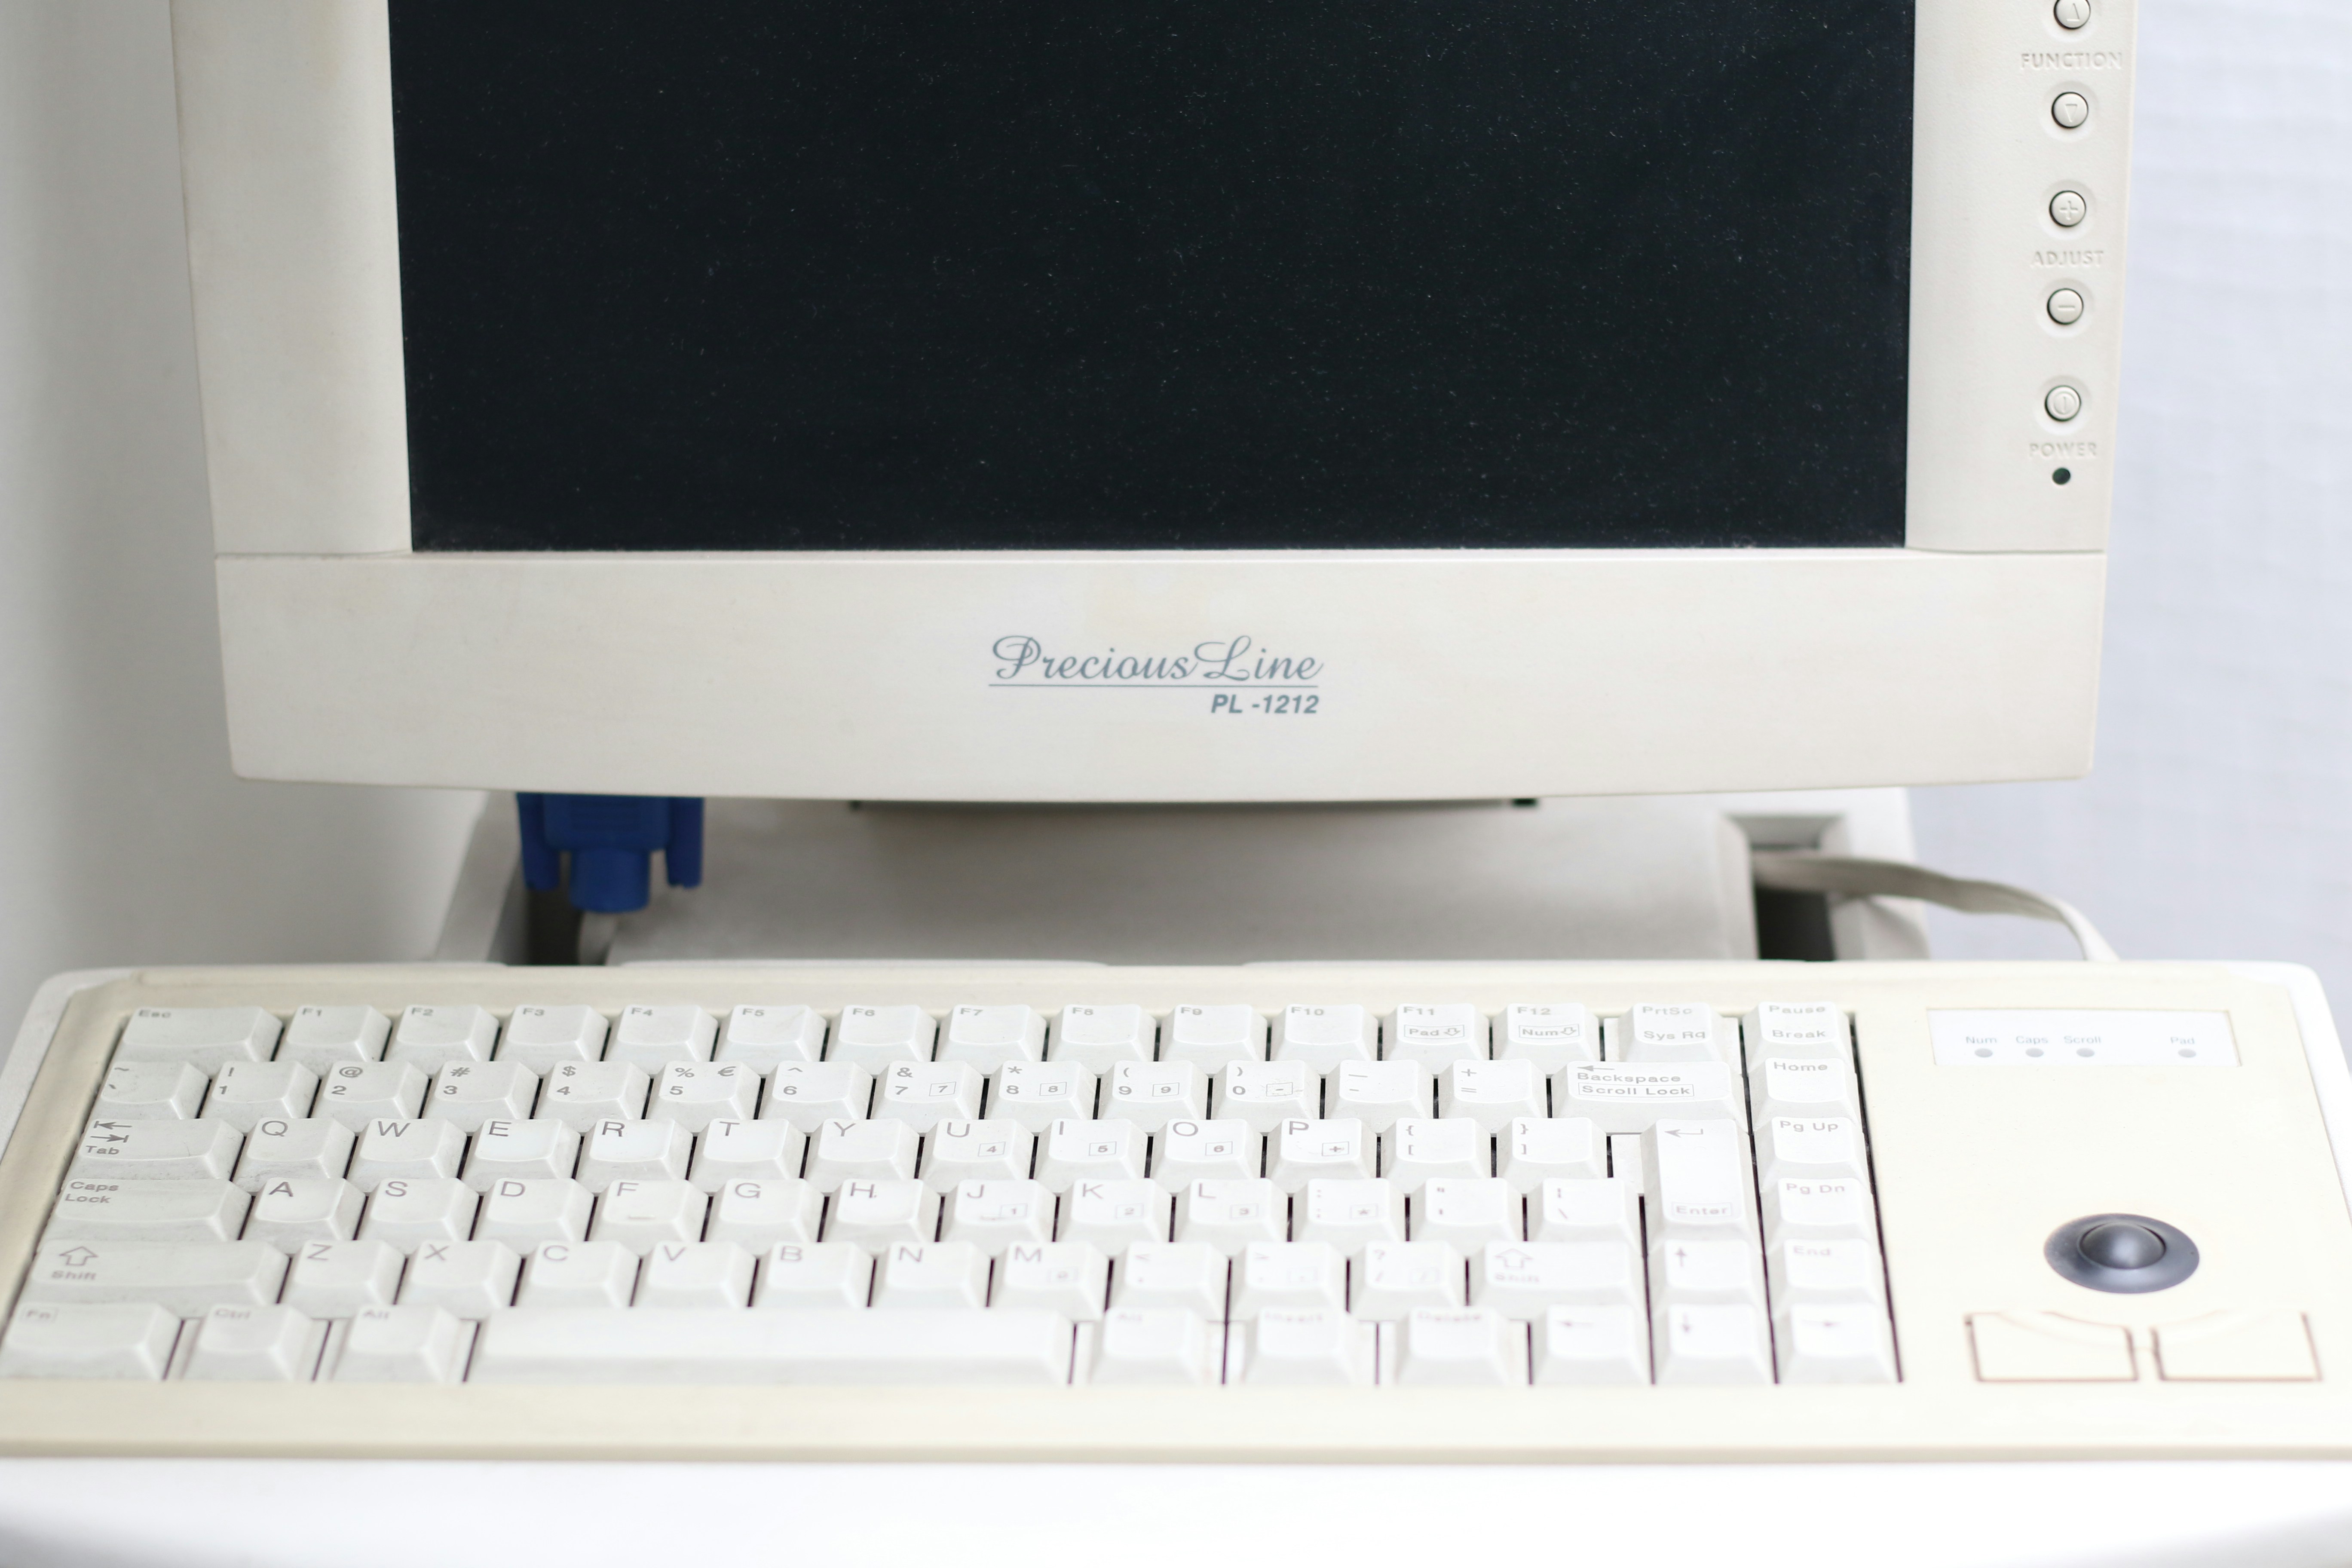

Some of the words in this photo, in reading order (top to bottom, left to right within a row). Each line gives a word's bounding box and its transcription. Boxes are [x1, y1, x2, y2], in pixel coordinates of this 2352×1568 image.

[2021, 52, 2122, 70] FUNCTION
[2031, 251, 2104, 267] ADJUST
[2029, 442, 2098, 458] POWER
[993, 635, 1199, 680] Precious
[1194, 635, 1324, 681] Line
[139, 1010, 171, 1018] Esc
[302, 1008, 322, 1017] F1
[411, 1008, 434, 1017] F2
[523, 1008, 545, 1017] F3
[631, 1008, 653, 1017] F4
[742, 1008, 765, 1017] F5
[852, 1008, 875, 1017] F6
[960, 1008, 983, 1016] F7
[1072, 1007, 1094, 1016] F8
[1181, 1007, 1203, 1016] F9
[1291, 1007, 1325, 1016] F10
[1403, 1007, 1434, 1016] F11
[1517, 1007, 1551, 1016] F12
[1642, 1006, 1692, 1015] PrtSc
[1769, 1005, 1825, 1014] Pause
[1644, 1031, 1675, 1041] Sys
[1772, 1030, 1825, 1038] Break
[1966, 1036, 1997, 1044] Num
[2015, 1036, 2049, 1045] Caps
[2064, 1035, 2101, 1044] Scroll
[339, 1066, 364, 1078] @
[451, 1067, 471, 1077] #
[562, 1065, 576, 1077] $
[717, 1066, 736, 1077] €
[1774, 1062, 1828, 1072] Home
[675, 1067, 695, 1078] %
[897, 1067, 913, 1078] &
[1577, 1072, 1681, 1084] Backspace
[220, 1085, 228, 1095] 1
[331, 1085, 347, 1095] 2
[443, 1085, 458, 1095] 3
[557, 1086, 571, 1096] 4
[670, 1085, 683, 1095] 5
[783, 1086, 797, 1095] 6
[895, 1086, 908, 1095] 7
[938, 1085, 948, 1093] 7
[1006, 1085, 1019, 1095] 8
[1119, 1086, 1132, 1095] 9
[1583, 1085, 1637, 1095] Scroll
[1645, 1087, 1690, 1095] Lock
[261, 1120, 288, 1137] Q
[378, 1121, 410, 1138] W
[488, 1121, 512, 1137] E
[601, 1121, 625, 1138] R
[720, 1121, 740, 1137] T
[833, 1121, 856, 1137] Y
[946, 1122, 970, 1138] U
[1173, 1121, 1199, 1137] O
[1289, 1121, 1309, 1135] P
[1780, 1121, 1804, 1133] Pg
[1813, 1122, 1838, 1132] Up
[87, 1145, 120, 1155] Tab
[71, 1182, 119, 1192] Caps
[269, 1181, 294, 1198] A
[385, 1181, 408, 1197] S
[500, 1181, 526, 1197] D
[617, 1182, 639, 1197] F
[735, 1182, 761, 1199] G
[850, 1182, 876, 1199] H
[967, 1184, 985, 1199] J
[1082, 1183, 1102, 1199] K
[1198, 1183, 1215, 1199] L
[1786, 1183, 1811, 1195] Pg
[1819, 1185, 1845, 1193] Dn
[65, 1194, 111, 1204] Lock
[1676, 1206, 1726, 1215] Enter
[307, 1244, 332, 1261] Z
[425, 1244, 448, 1261] X
[543, 1245, 569, 1262] C
[664, 1246, 686, 1262] V
[780, 1246, 802, 1262] B
[899, 1246, 923, 1263] N
[1015, 1246, 1042, 1262] M
[1794, 1247, 1831, 1257] End
[52, 1271, 97, 1280] Shift
